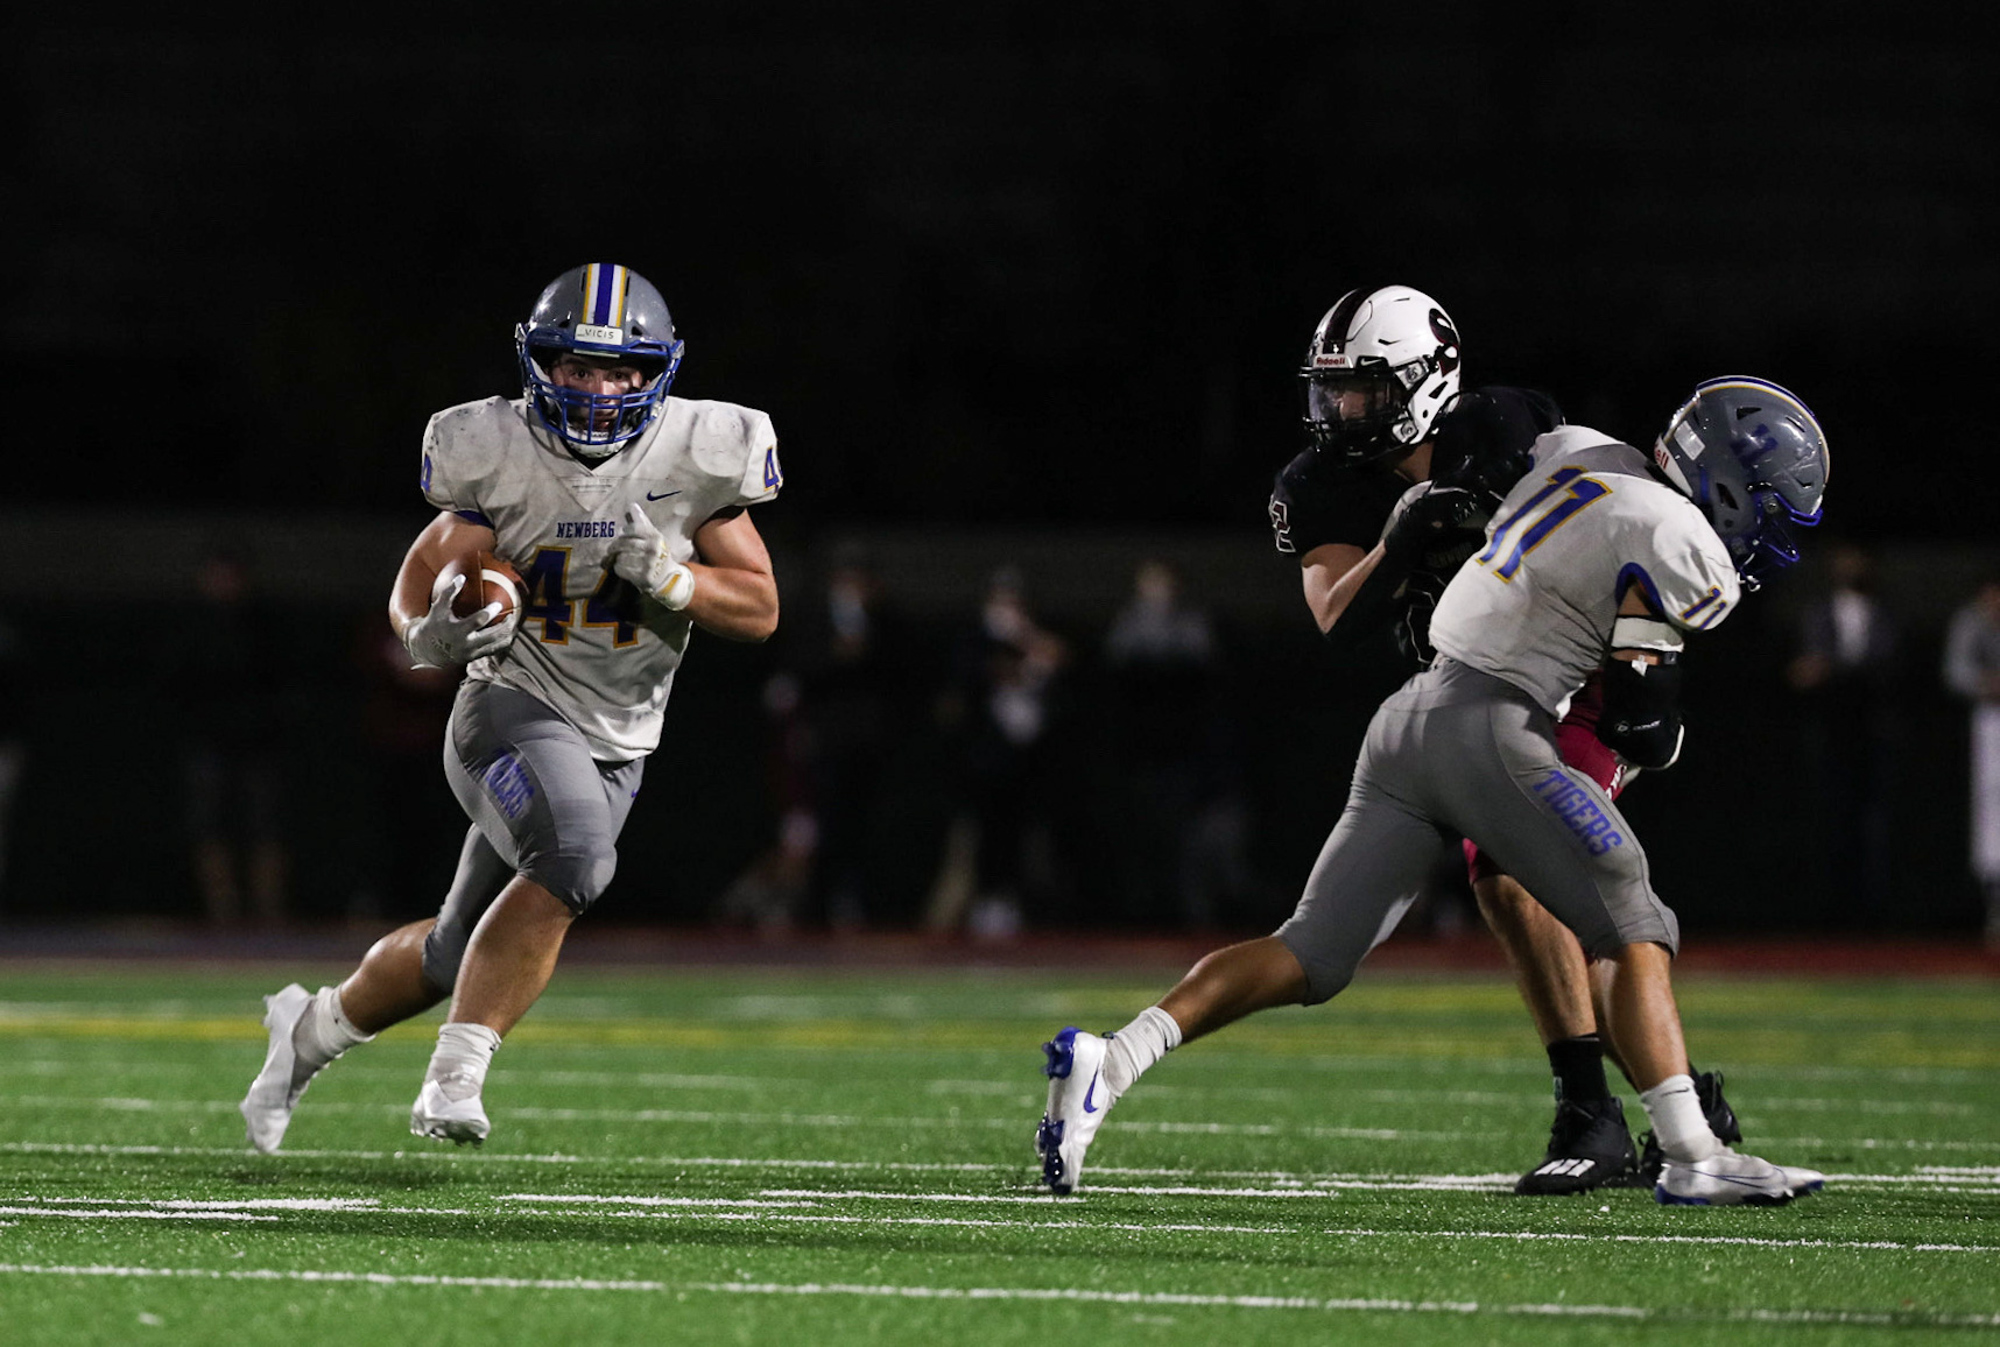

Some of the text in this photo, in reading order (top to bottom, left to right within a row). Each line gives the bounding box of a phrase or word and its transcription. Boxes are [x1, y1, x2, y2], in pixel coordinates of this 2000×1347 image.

[1316, 357, 1346, 366] Riddell
[763, 445, 784, 496] 4
[556, 521, 616, 538] NEWBERG
[1475, 465, 1613, 584] 11
[525, 545, 640, 648] 44
[1678, 585, 1727, 631] 11
[1532, 769, 1623, 857] TIGERS
